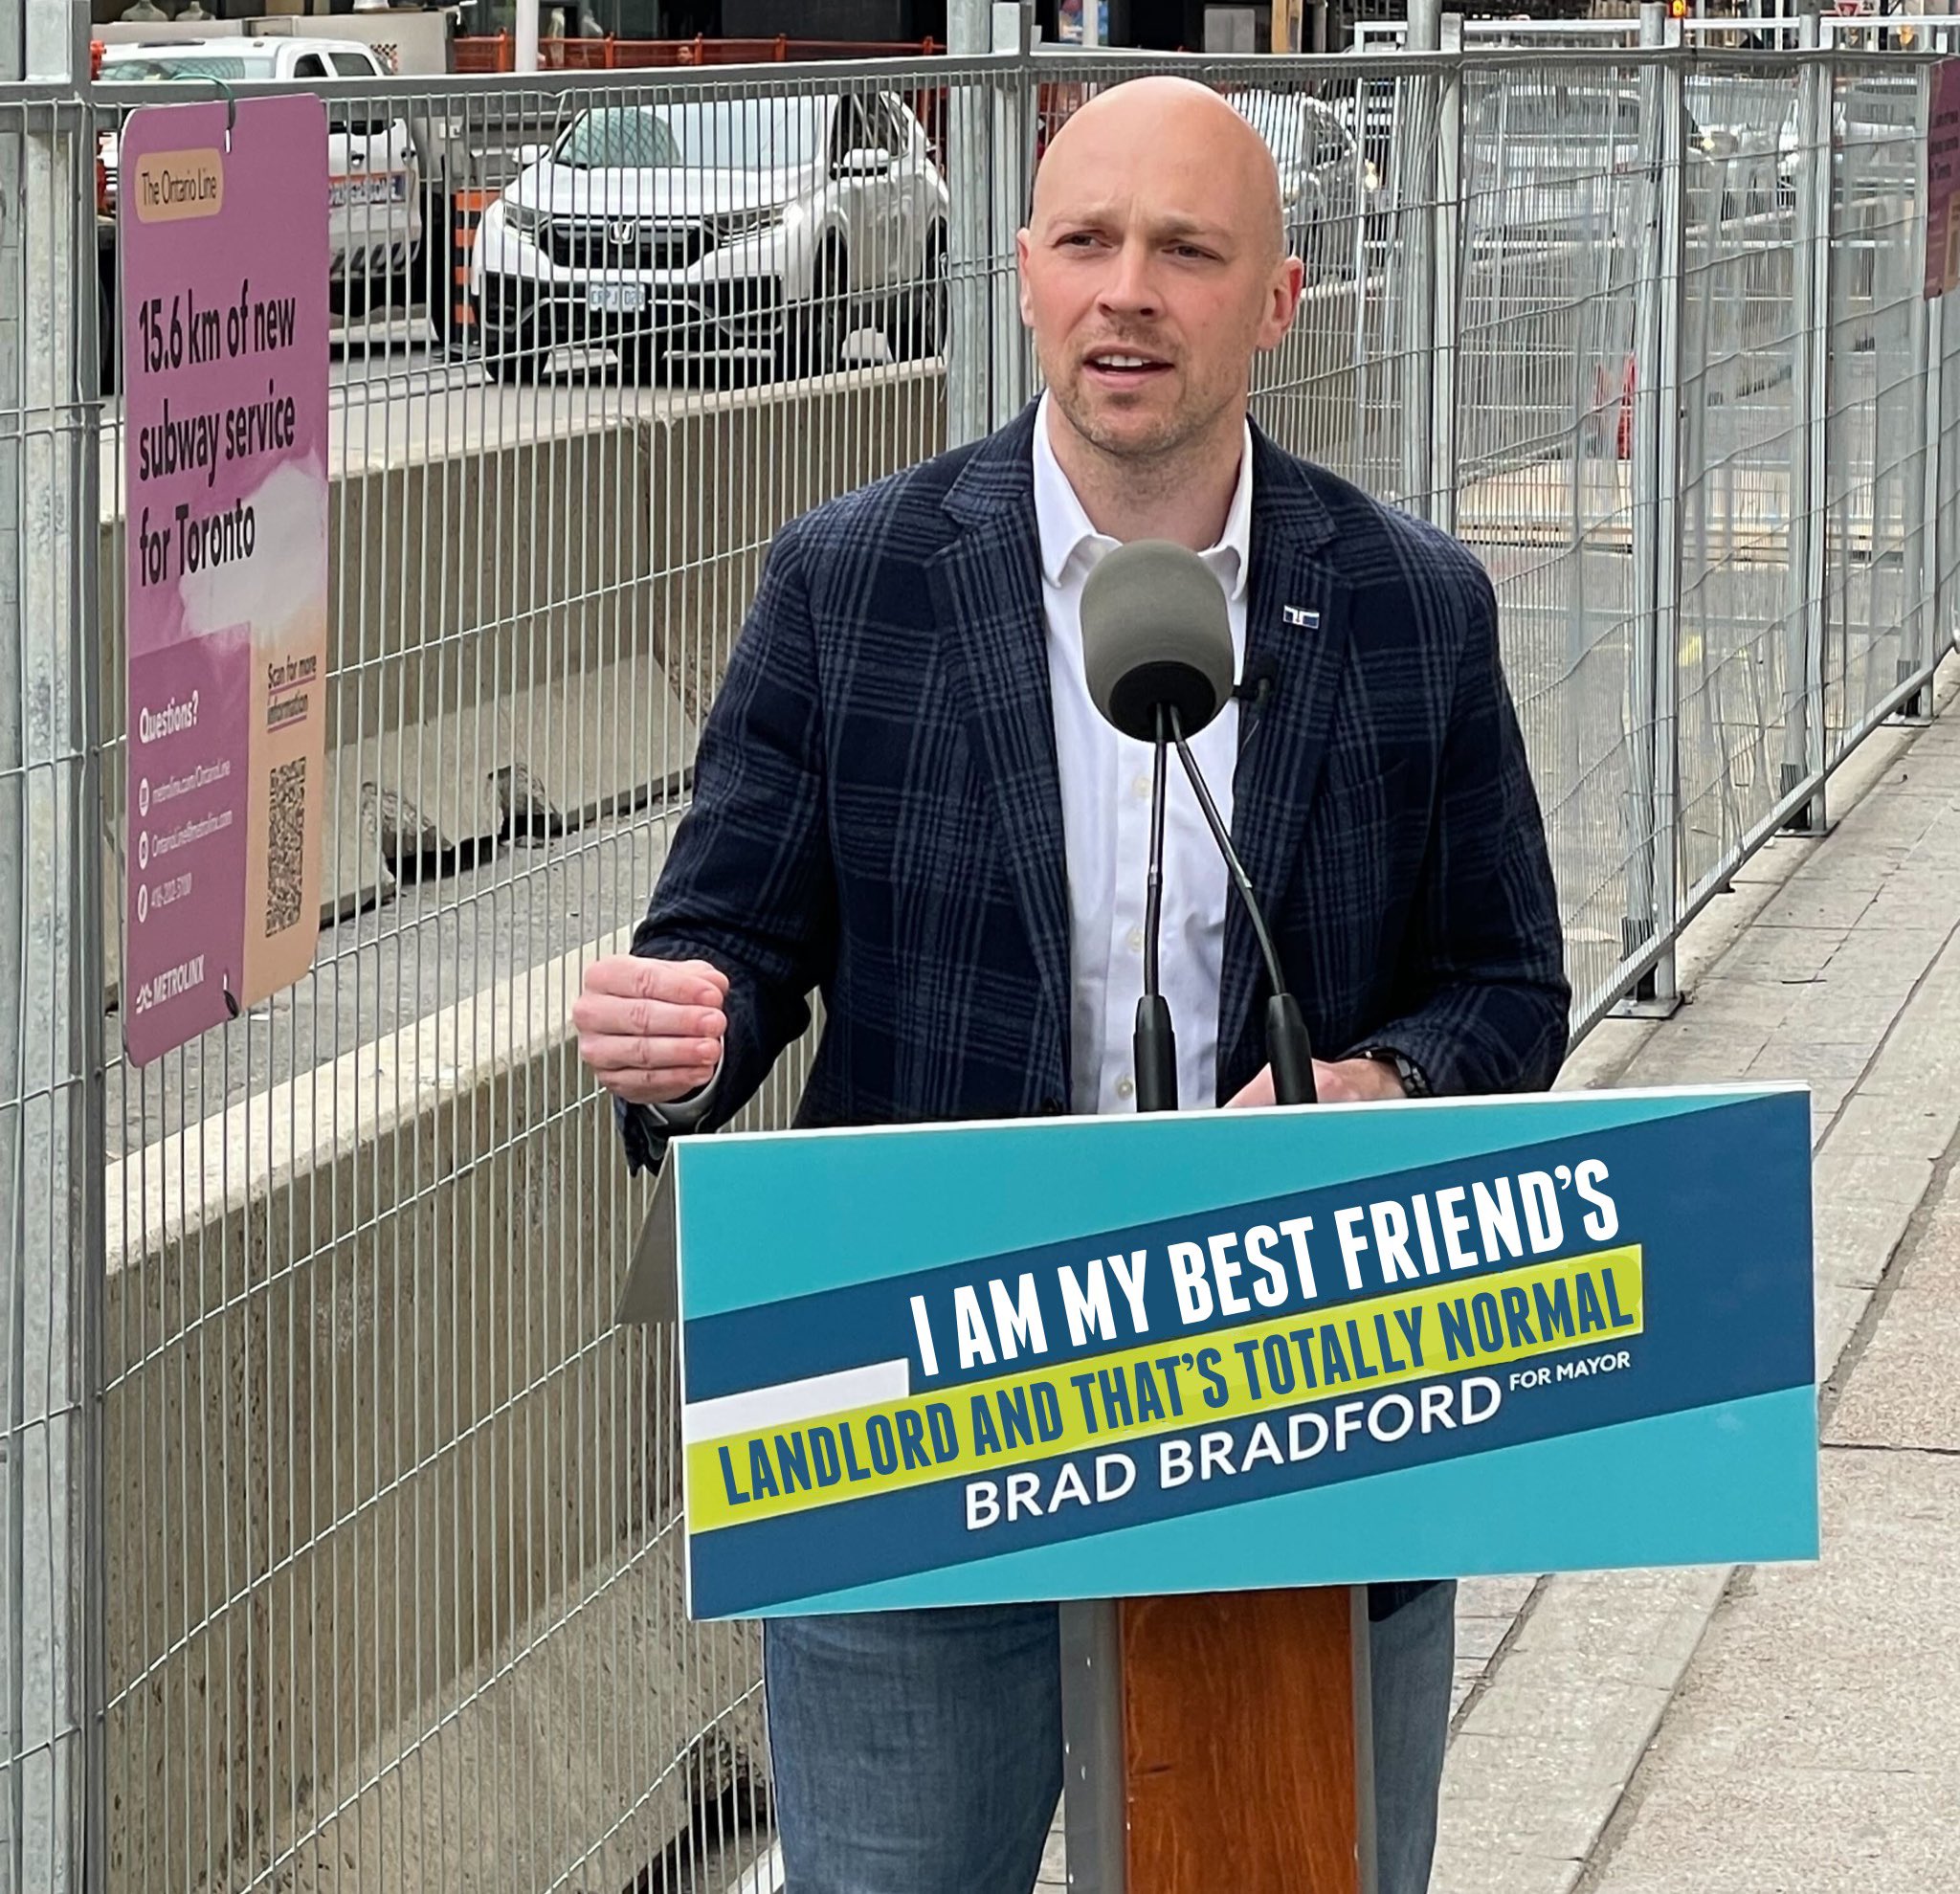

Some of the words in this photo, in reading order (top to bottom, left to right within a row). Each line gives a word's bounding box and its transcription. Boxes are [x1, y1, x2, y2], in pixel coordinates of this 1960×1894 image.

[142, 171, 160, 206] The
[162, 169, 196, 204] Ontario
[198, 167, 216, 200] Line
[139, 296, 183, 372] 15.6
[189, 288, 220, 364] km
[227, 279, 249, 357] of
[254, 298, 296, 352] new
[140, 398, 220, 488] subway
[226, 378, 295, 460] service
[140, 507, 170, 587] for
[175, 498, 256, 576] Toronto
[140, 689, 199, 744] Questions?
[153, 954, 205, 1006] METROLINX
[910, 1296, 939, 1376] I
[954, 1273, 1047, 1369] AM
[1058, 1250, 1148, 1346] MY
[1168, 1216, 1317, 1325] BEST
[1334, 1159, 1618, 1289] FRIEND'S
[719, 1403, 959, 1505] LANDLORD
[970, 1382, 1063, 1456] AND
[1070, 1348, 1229, 1434] THAT'S
[1235, 1306, 1424, 1400] TOTALLY
[1437, 1268, 1634, 1361] NORMAL
[1510, 1369, 1550, 1391] FOR
[1554, 1351, 1630, 1381] MAYOR
[967, 1454, 1135, 1529] BRAD
[1161, 1377, 1501, 1488] BRADFORD
